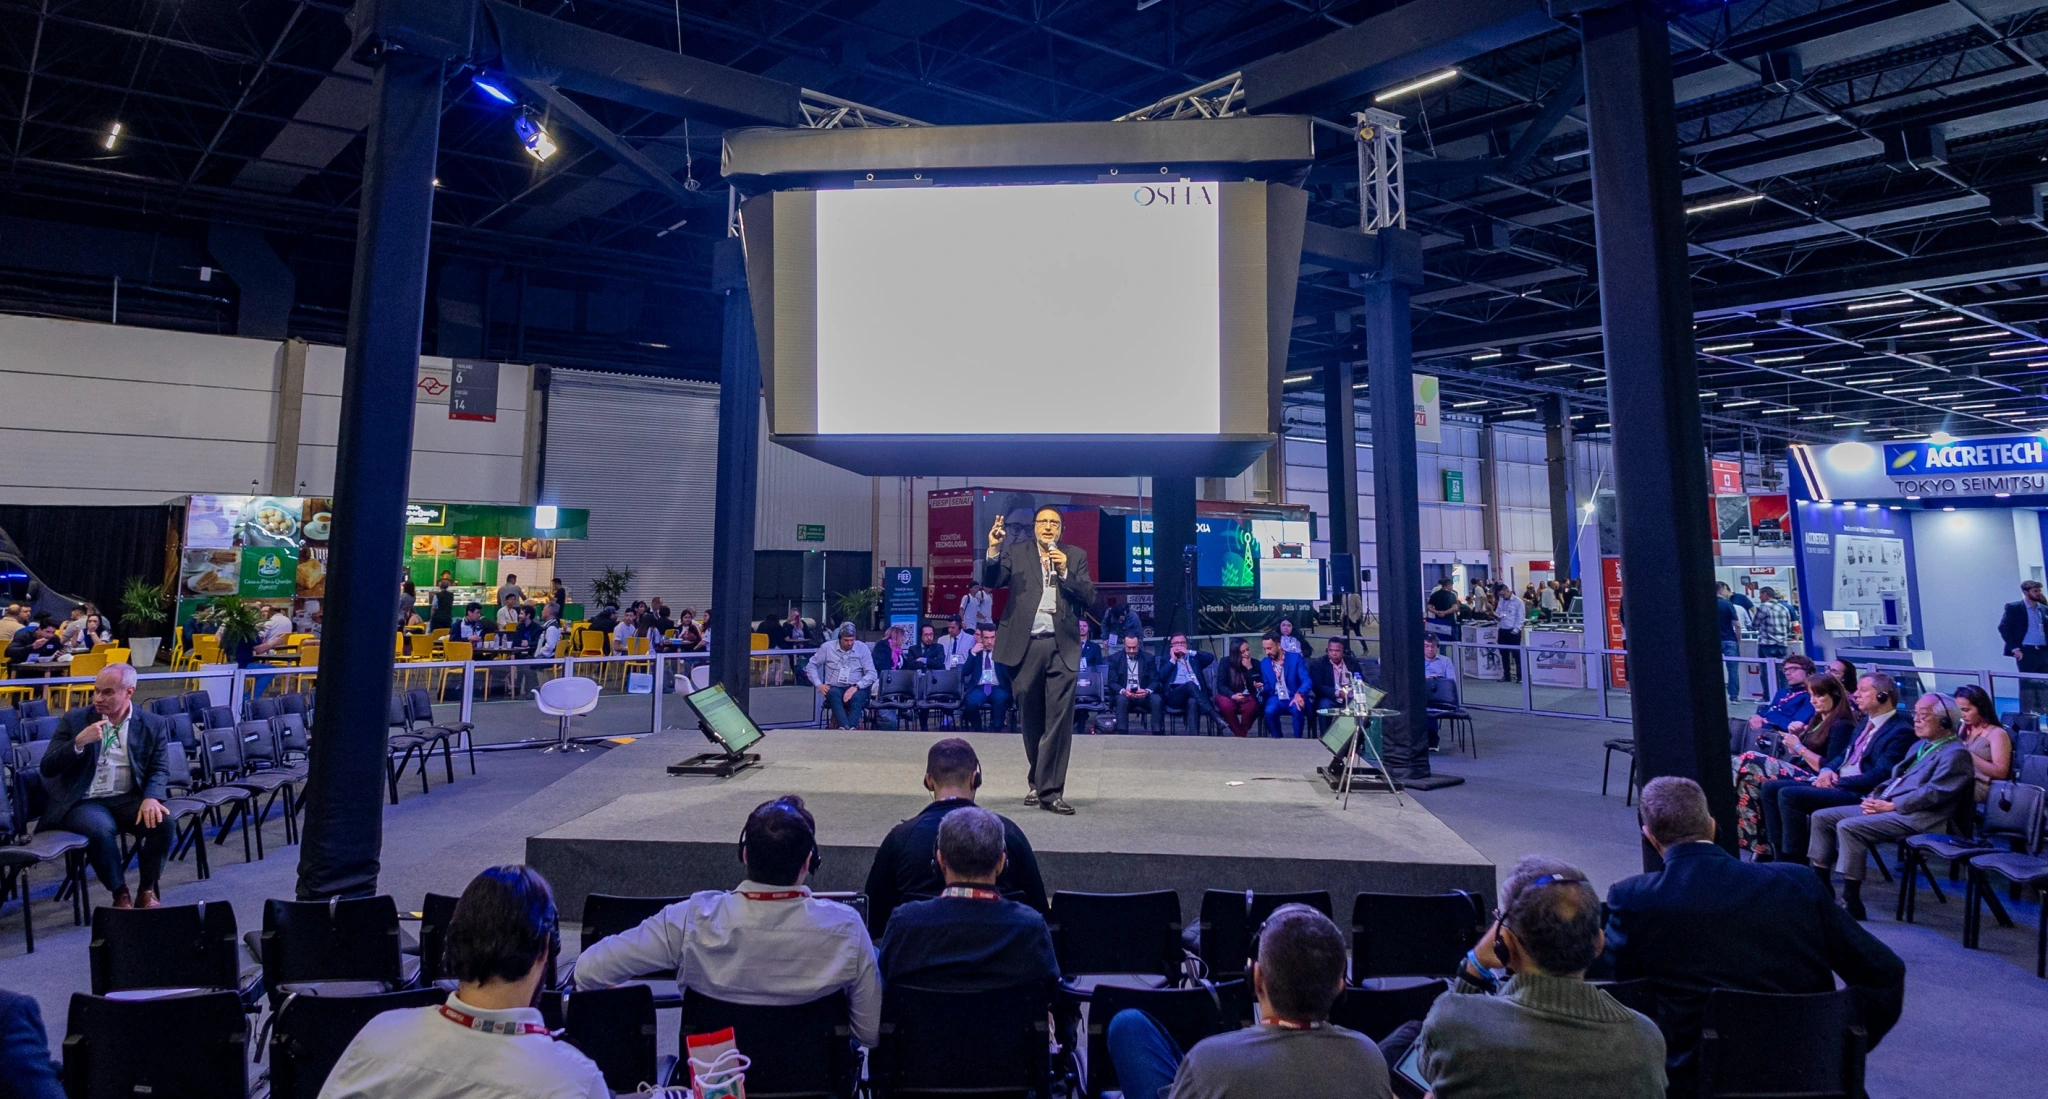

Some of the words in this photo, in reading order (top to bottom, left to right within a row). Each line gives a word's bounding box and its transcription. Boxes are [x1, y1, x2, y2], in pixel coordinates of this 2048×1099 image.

[456, 371, 463, 384] 6
[454, 399, 466, 410] 14
[1925, 442, 2043, 468] ACCRETECH
[1894, 479, 1956, 494] TOKYO
[1962, 475, 2045, 491] SEIMITSU
[932, 499, 949, 507] FIESP
[951, 497, 970, 505] SENAI
[940, 533, 961, 541] CONTÉM
[1805, 532, 1829, 545] ACCRETECH
[897, 573, 909, 581] FIEE
[1206, 604, 1224, 612] Forte
[1231, 603, 1258, 612] Indústria
[1282, 603, 1294, 611] País
